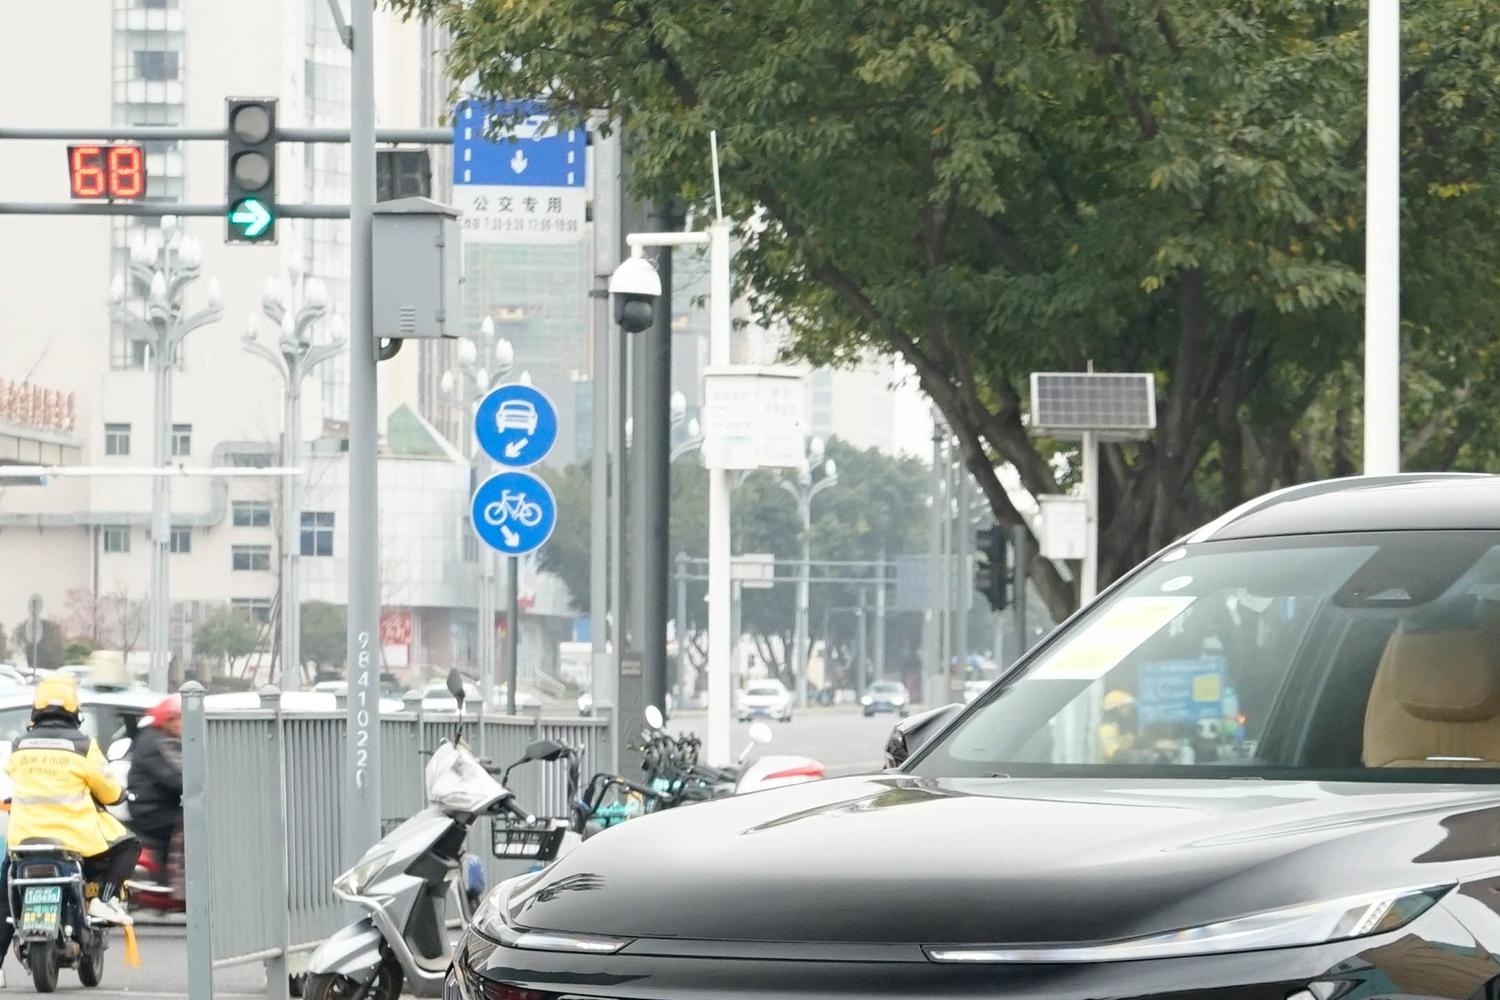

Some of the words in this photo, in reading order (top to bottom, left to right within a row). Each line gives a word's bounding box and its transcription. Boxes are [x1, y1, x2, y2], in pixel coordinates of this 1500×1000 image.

[73, 147, 142, 197] 68
[473, 196, 562, 213] 公交专用
